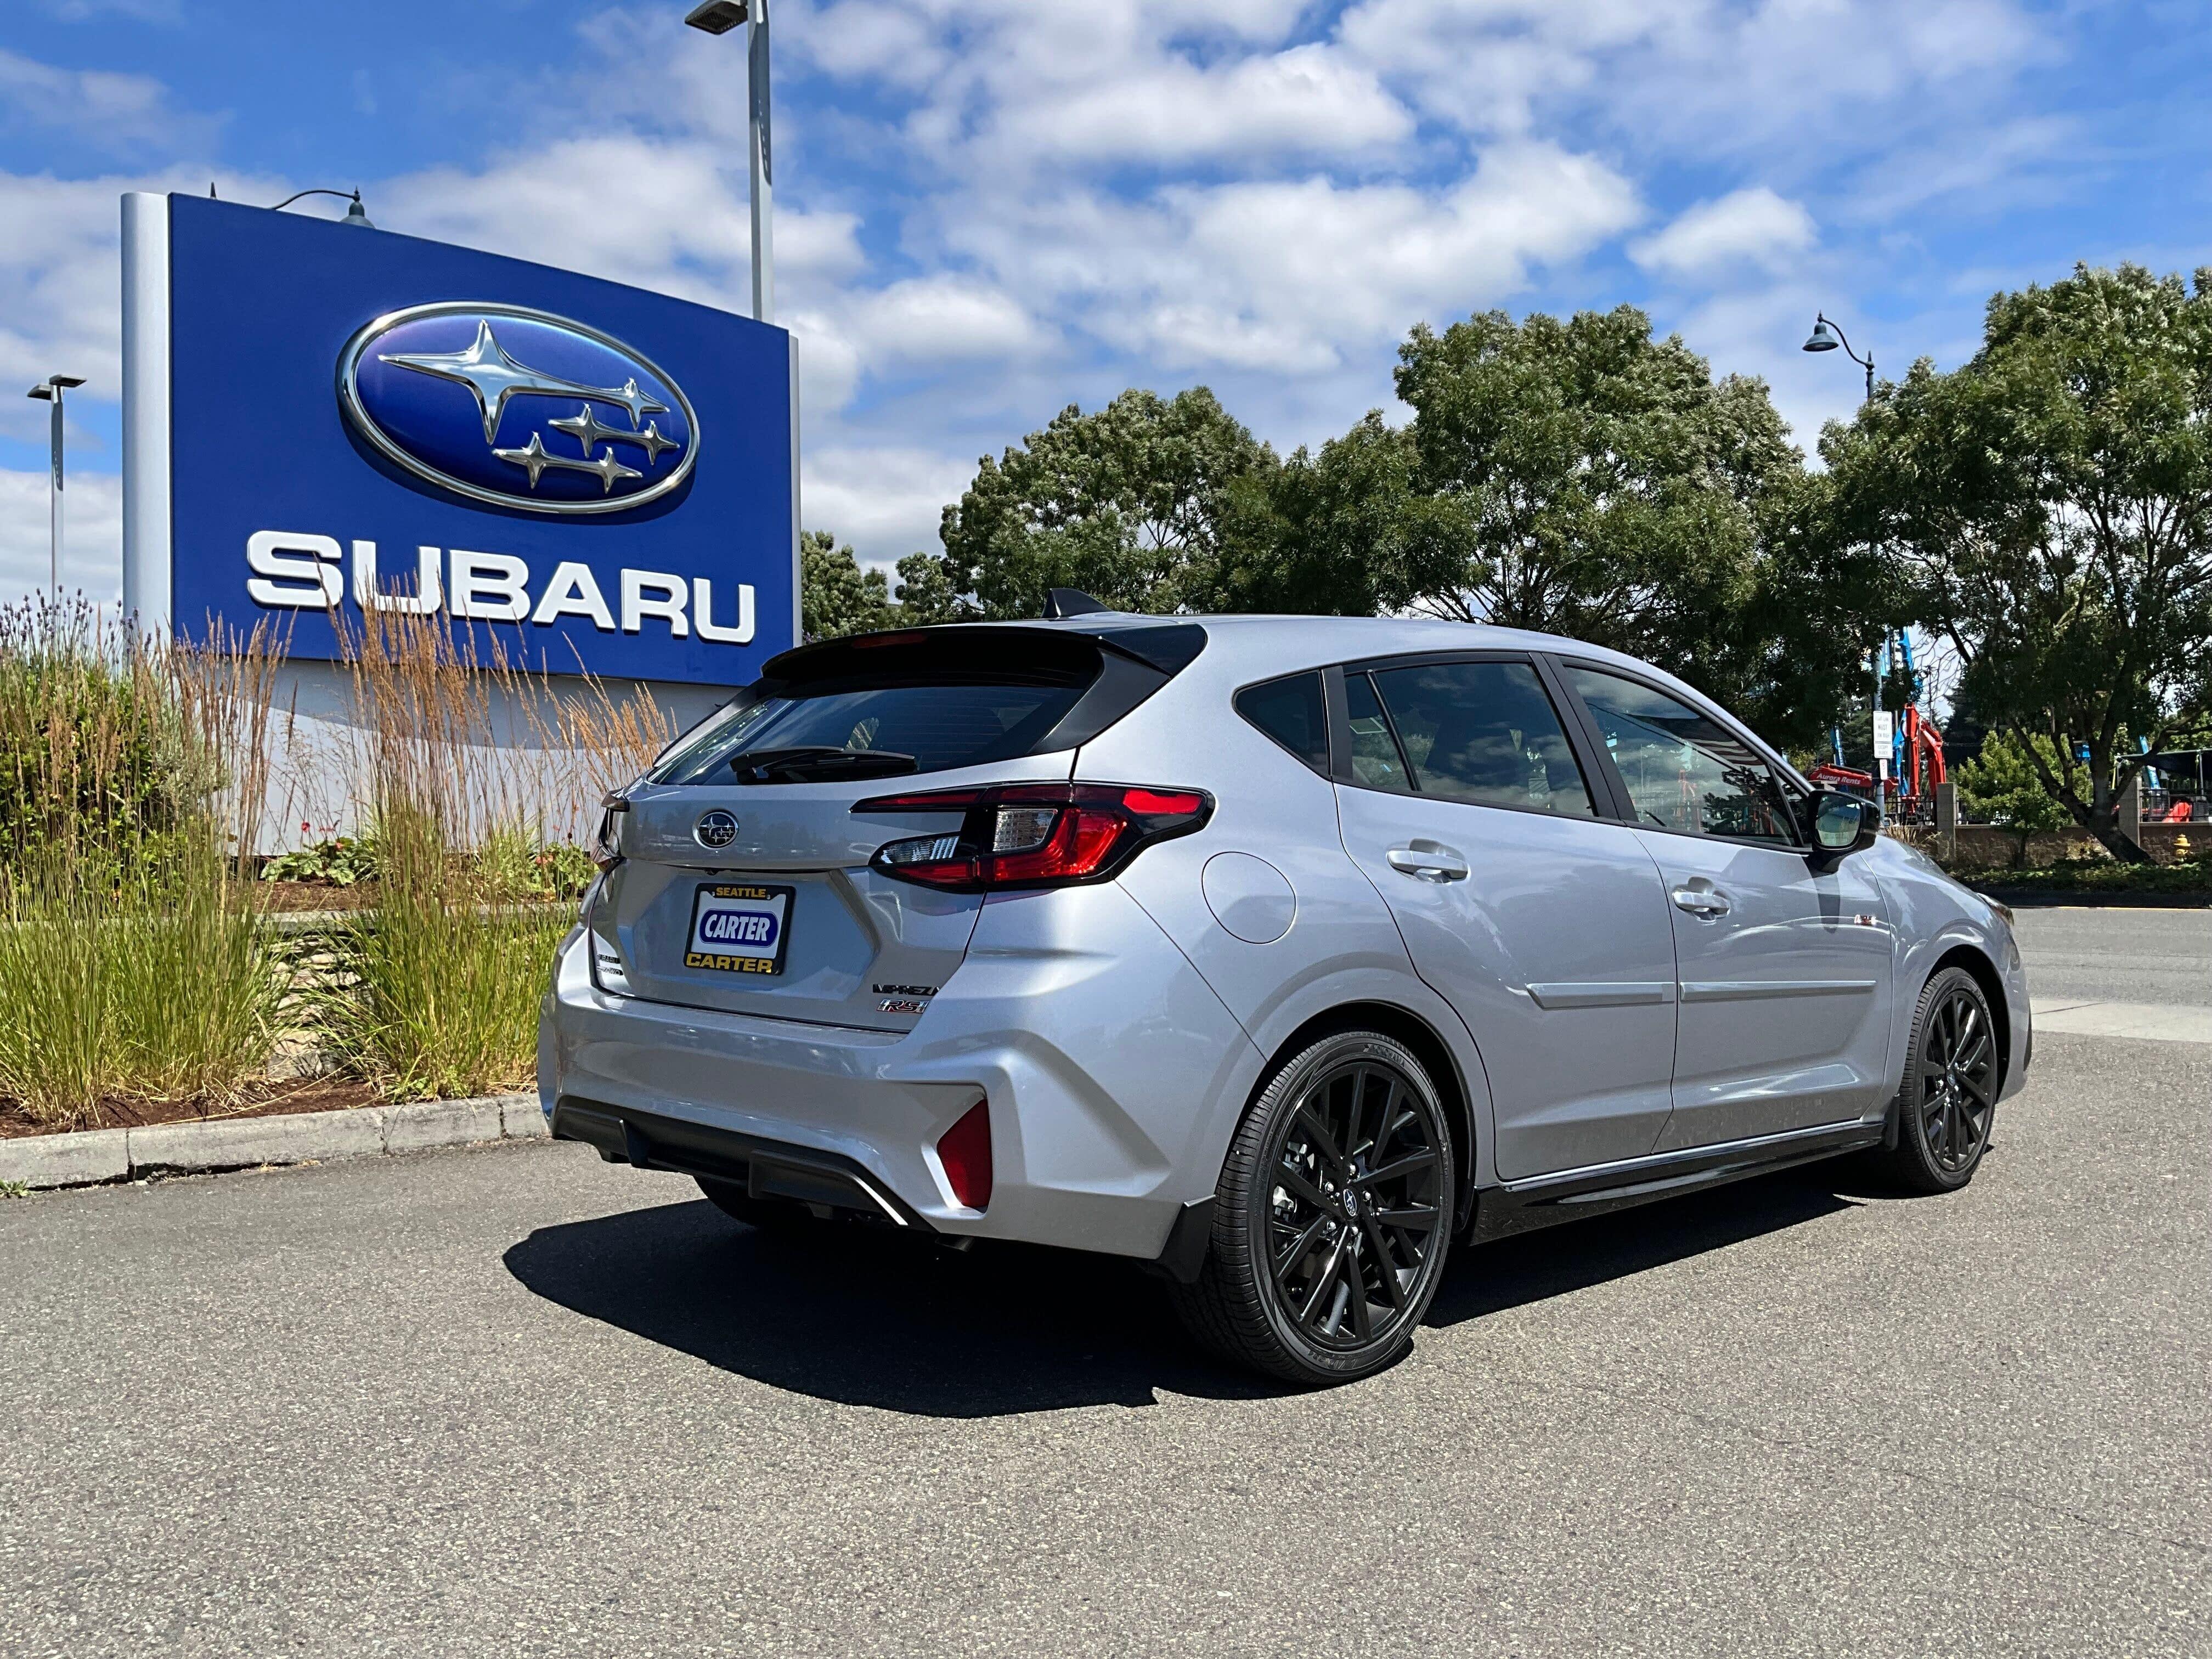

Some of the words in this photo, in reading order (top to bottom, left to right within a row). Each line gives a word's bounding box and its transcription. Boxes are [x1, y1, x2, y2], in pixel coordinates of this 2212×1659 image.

[246, 529, 755, 643] SUBARU
[1817, 773, 1840, 782] Aurora
[1841, 776, 1861, 785] Rents
[716, 887, 766, 898] SEATTLE
[704, 914, 770, 941] CARTER
[686, 953, 773, 973] CARTER
